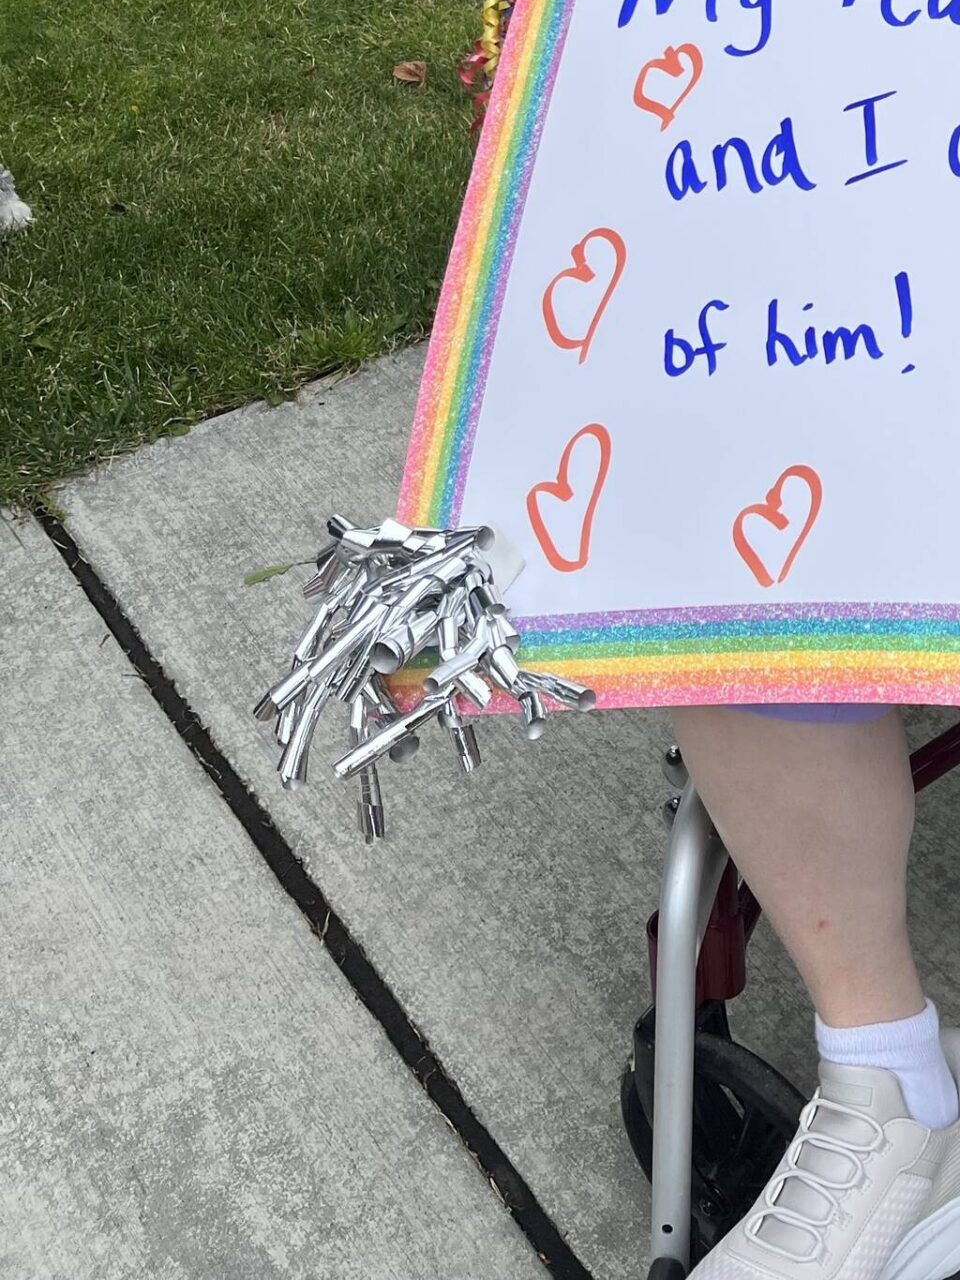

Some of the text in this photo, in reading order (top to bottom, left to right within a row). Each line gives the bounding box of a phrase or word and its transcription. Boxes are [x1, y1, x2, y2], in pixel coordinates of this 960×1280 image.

[665, 117, 817, 201] and
[843, 90, 909, 186] I
[663, 271, 916, 377] of him!
